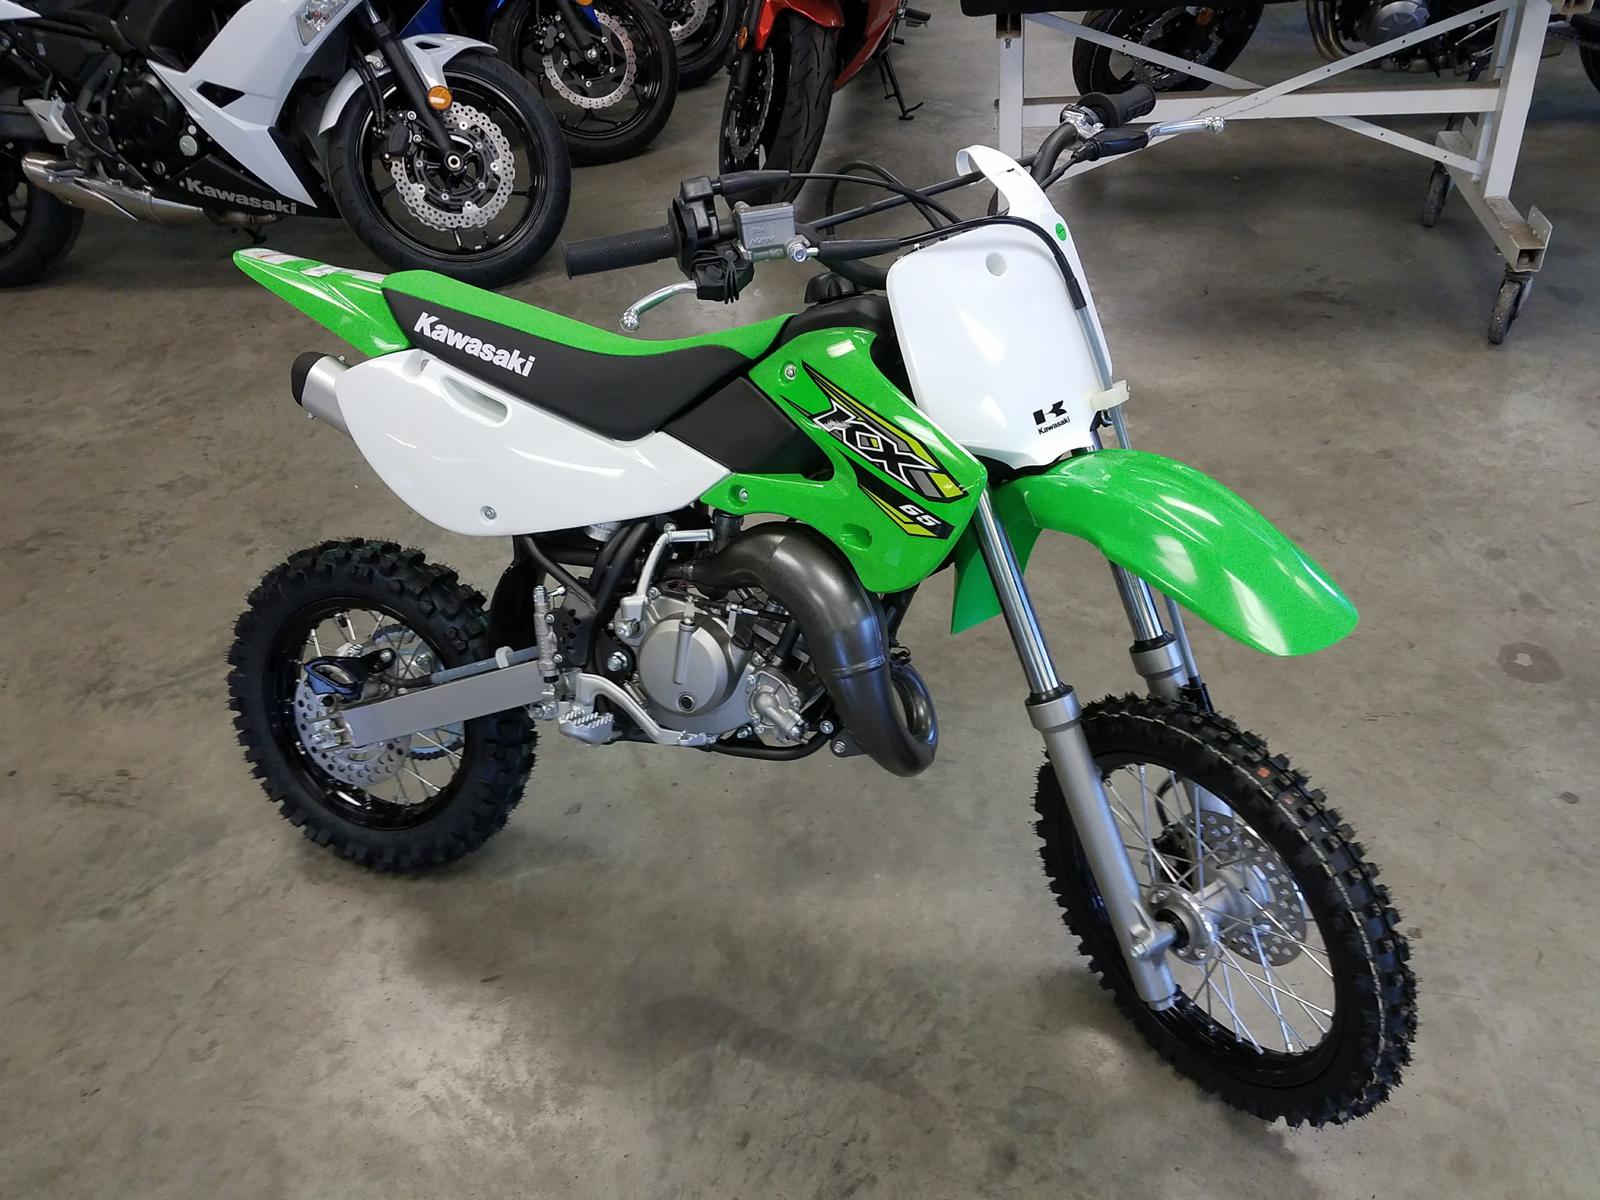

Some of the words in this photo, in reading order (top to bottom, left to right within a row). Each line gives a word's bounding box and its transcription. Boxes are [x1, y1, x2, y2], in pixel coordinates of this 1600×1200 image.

[185, 177, 297, 214] Kawasaki
[413, 311, 536, 377] Kawasaki
[1038, 416, 1070, 435] Kawasaki
[899, 504, 942, 526] 65
